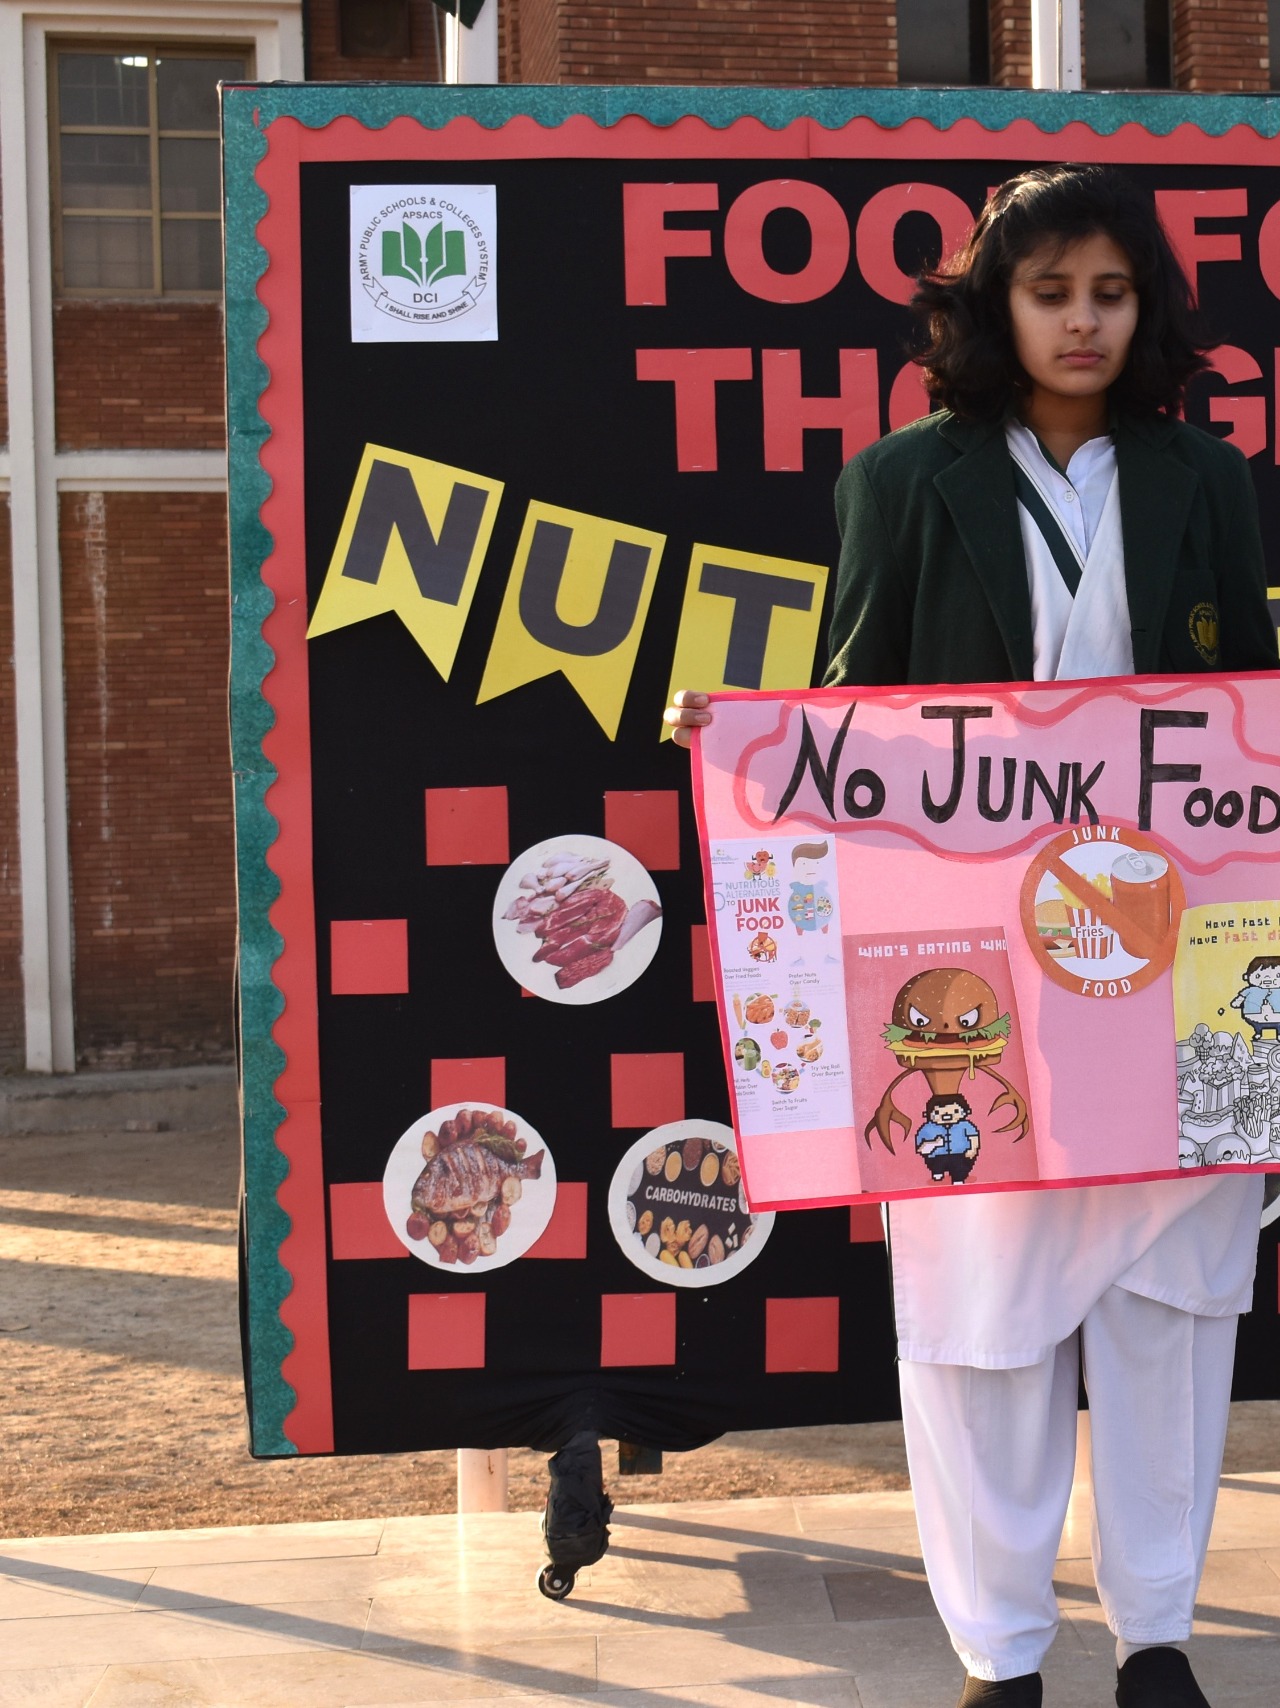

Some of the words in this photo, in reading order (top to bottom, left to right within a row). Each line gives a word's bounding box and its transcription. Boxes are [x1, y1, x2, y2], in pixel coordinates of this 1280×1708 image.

[380, 196, 427, 218] SCHOOLS
[430, 197, 436, 206] &
[402, 211, 443, 219] APSACS
[439, 200, 482, 239] COLLEGES
[360, 217, 381, 249] PUBLIC
[622, 178, 1000, 306] FOO
[359, 252, 371, 281] ARMY
[477, 241, 488, 281] SYSTEM
[413, 293, 438, 303] DCI
[389, 305, 411, 319] SHALL
[431, 311, 447, 320] AND
[448, 301, 468, 316] SHINE
[920, 705, 1105, 825] JUNK
[1072, 825, 1121, 844] JUNK
[725, 880, 780, 890] NUTRITIOUS
[726, 888, 780, 899] ALTERNATIVES
[735, 897, 780, 917] JUNK
[736, 915, 784, 932] FOOD
[1075, 926, 1104, 938] Fries
[1205, 919, 1235, 930] Have
[858, 944, 909, 958] WHO'S
[917, 941, 971, 956] EATING
[1189, 935, 1218, 946] Have
[1081, 978, 1132, 997] FOOD
[645, 1185, 737, 1213] CARBOHYDRATES
